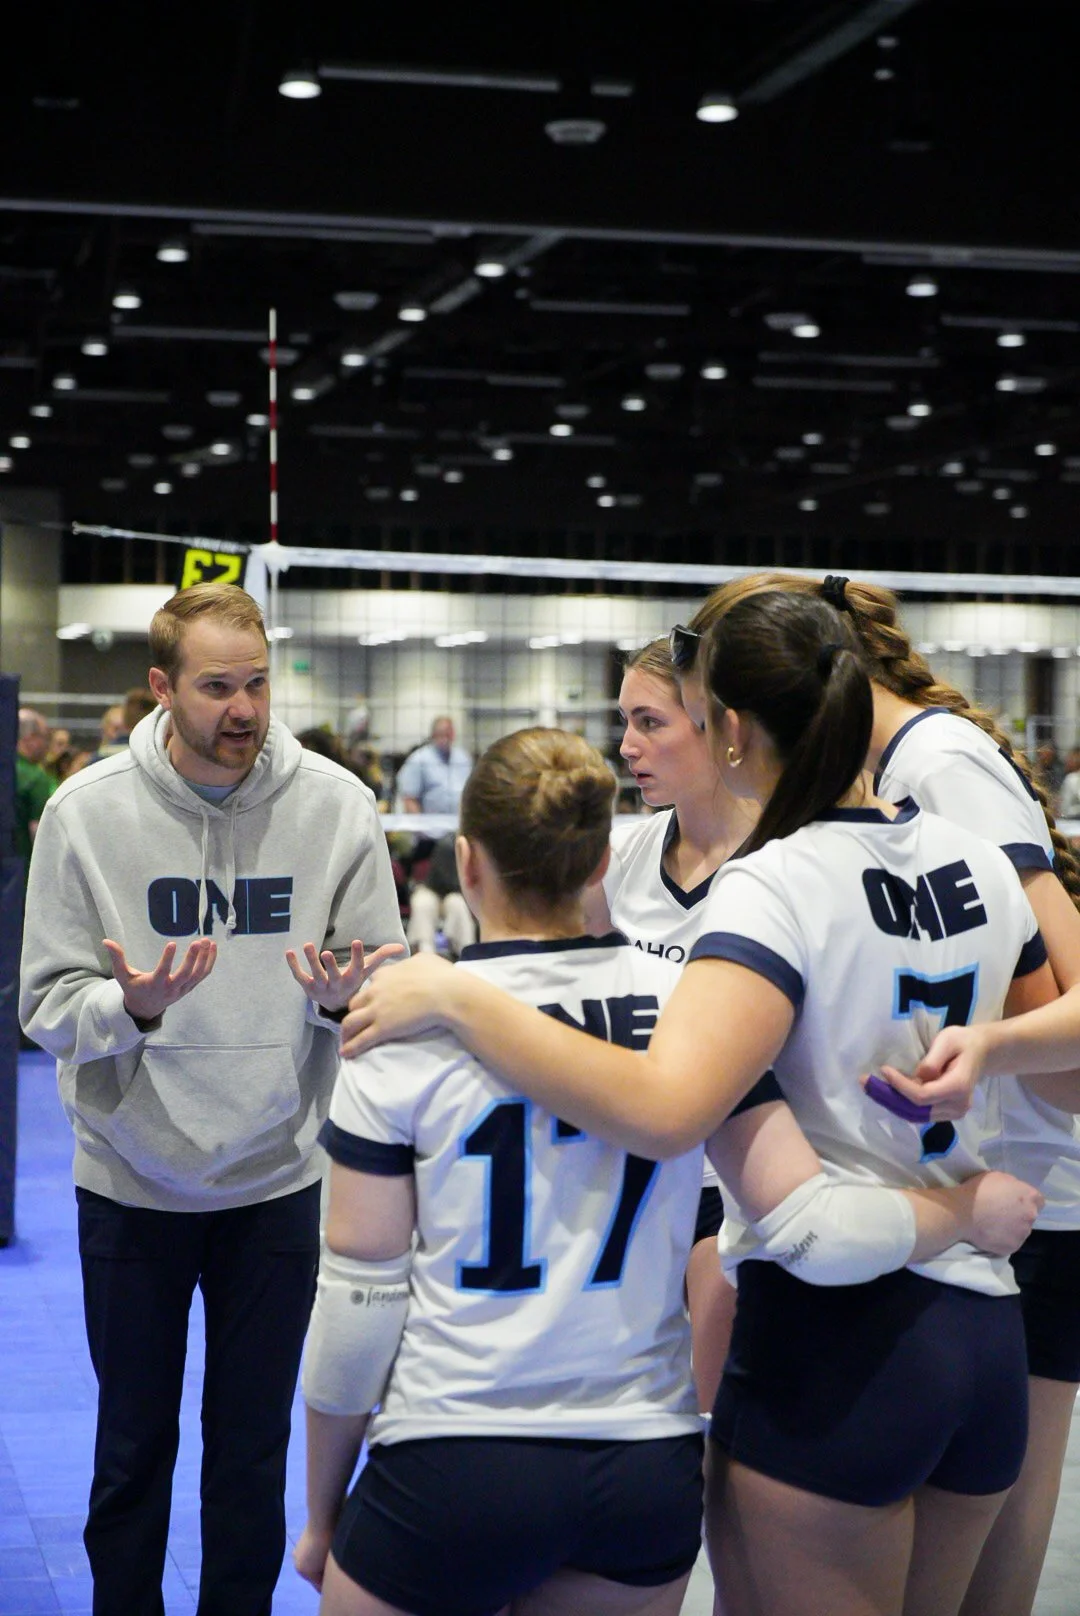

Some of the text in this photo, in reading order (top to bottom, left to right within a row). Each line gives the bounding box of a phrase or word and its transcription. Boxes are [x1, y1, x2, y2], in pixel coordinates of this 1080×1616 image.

[147, 876, 293, 937] ONE
[862, 859, 988, 942] ONE
[635, 939, 686, 964] AHO
[537, 994, 660, 1051] NE
[891, 961, 979, 1164] 7
[455, 1095, 662, 1298] 17
